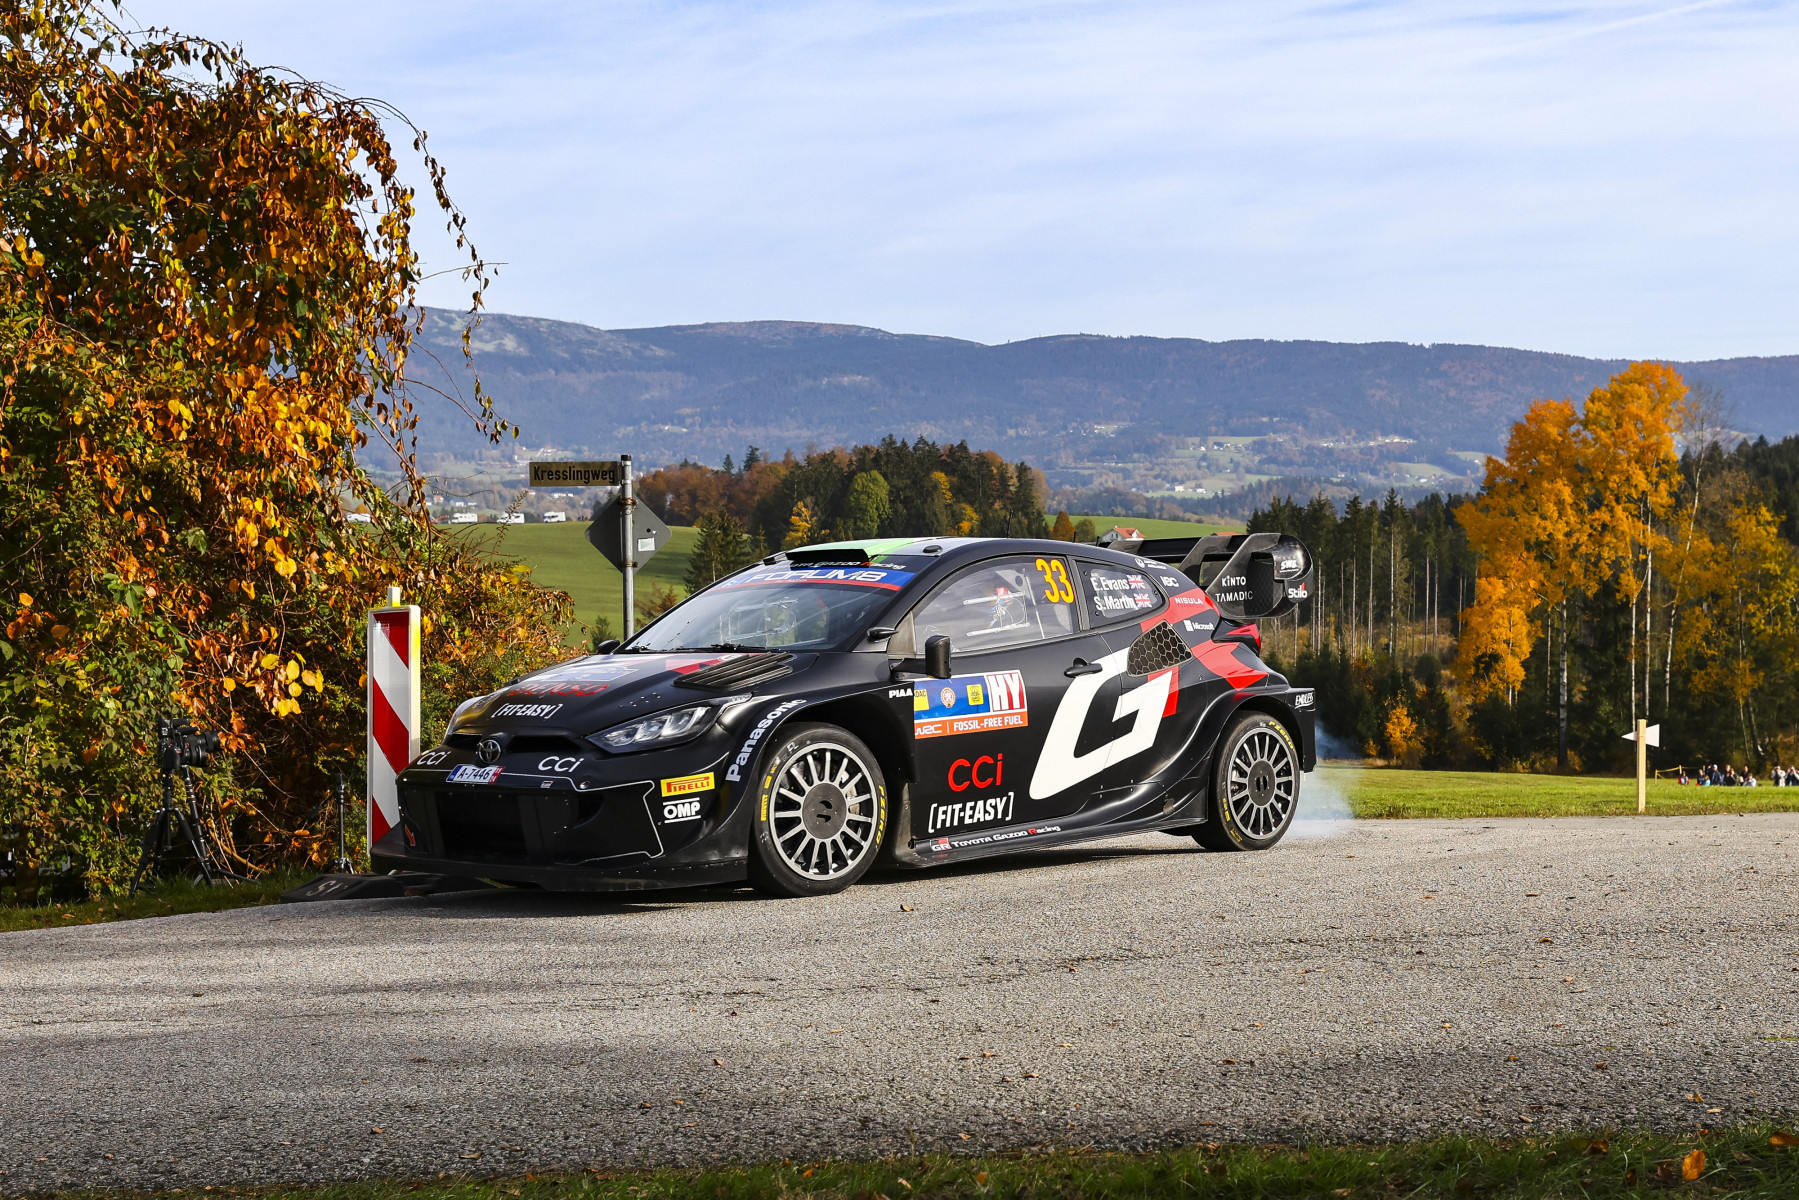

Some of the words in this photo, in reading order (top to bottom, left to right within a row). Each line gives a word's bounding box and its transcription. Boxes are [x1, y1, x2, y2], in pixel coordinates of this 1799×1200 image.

[533, 465, 617, 484] Kresslingweg
[1035, 557, 1075, 604] 33
[1215, 591, 1254, 603] TAMADIC
[1288, 582, 1308, 599] Stilo
[1174, 597, 1204, 605] NISULA
[506, 682, 611, 697] DENSO
[888, 688, 914, 699] PIAA
[986, 672, 1024, 712] HY
[953, 716, 1003, 732] FOSSIL-FREE
[1004, 714, 1024, 726] FUEL
[725, 698, 808, 782] Panasonic
[457, 767, 492, 780] A-7446
[666, 776, 710, 793] PIRELLI
[663, 801, 701, 819] OMP
[951, 836, 992, 848] TOYOTA
[993, 830, 1029, 841] GAZOO
[1027, 825, 1062, 836] Racing
